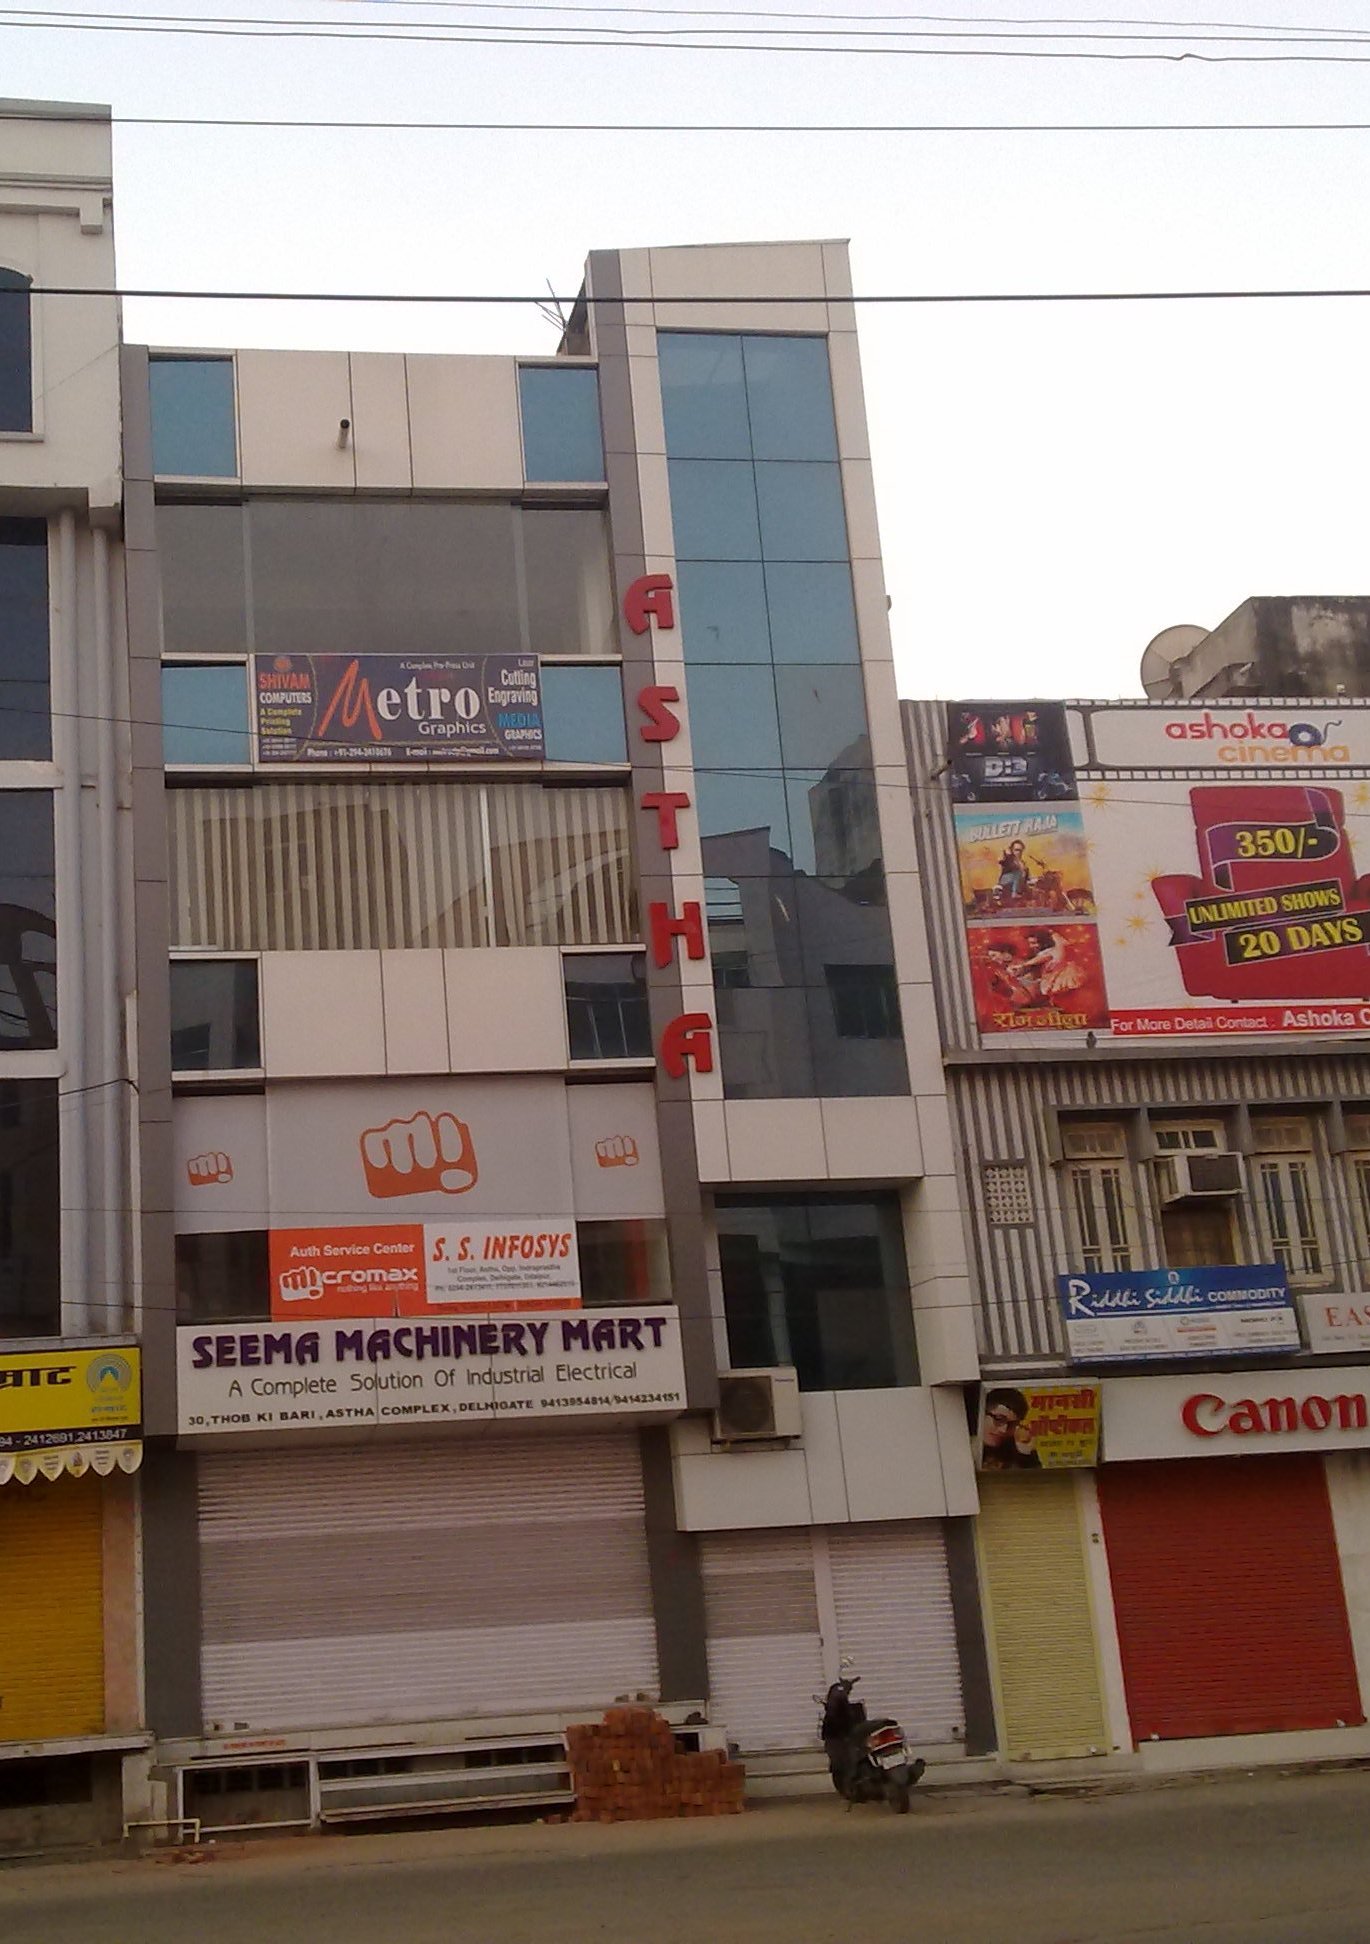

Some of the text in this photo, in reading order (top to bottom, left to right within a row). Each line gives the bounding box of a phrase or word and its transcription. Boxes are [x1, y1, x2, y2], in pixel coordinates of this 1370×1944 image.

[259, 672, 310, 689] SHIVAM
[501, 669, 537, 688] Cutting
[260, 692, 312, 704] COMPUTERS
[488, 687, 538, 706] Engraving
[418, 721, 487, 738] Graphics
[504, 728, 543, 740] GRAPHICS
[1166, 711, 1291, 741] ashoka
[1218, 740, 1350, 763] cinema
[1236, 828, 1318, 858] 350/-
[1188, 888, 1341, 925] UNLIMITED SHOWS
[1240, 919, 1364, 958] 20 DAYS
[1111, 1018, 1134, 1032] For
[1136, 1017, 1171, 1031] More
[1174, 1016, 1213, 1030] Detail
[1282, 1009, 1354, 1028] Ashoka
[290, 1243, 415, 1257] Auth Service Center
[483, 1232, 572, 1260] INFOSYS
[1208, 1287, 1286, 1303] COMMODITY
[192, 1317, 667, 1369] SEEMA MACHINERY MART
[229, 1362, 637, 1398] A Complete Solution Of Industrial Electrical
[257, 1412, 273, 1422] KI
[1181, 1393, 1367, 1438] Canon
